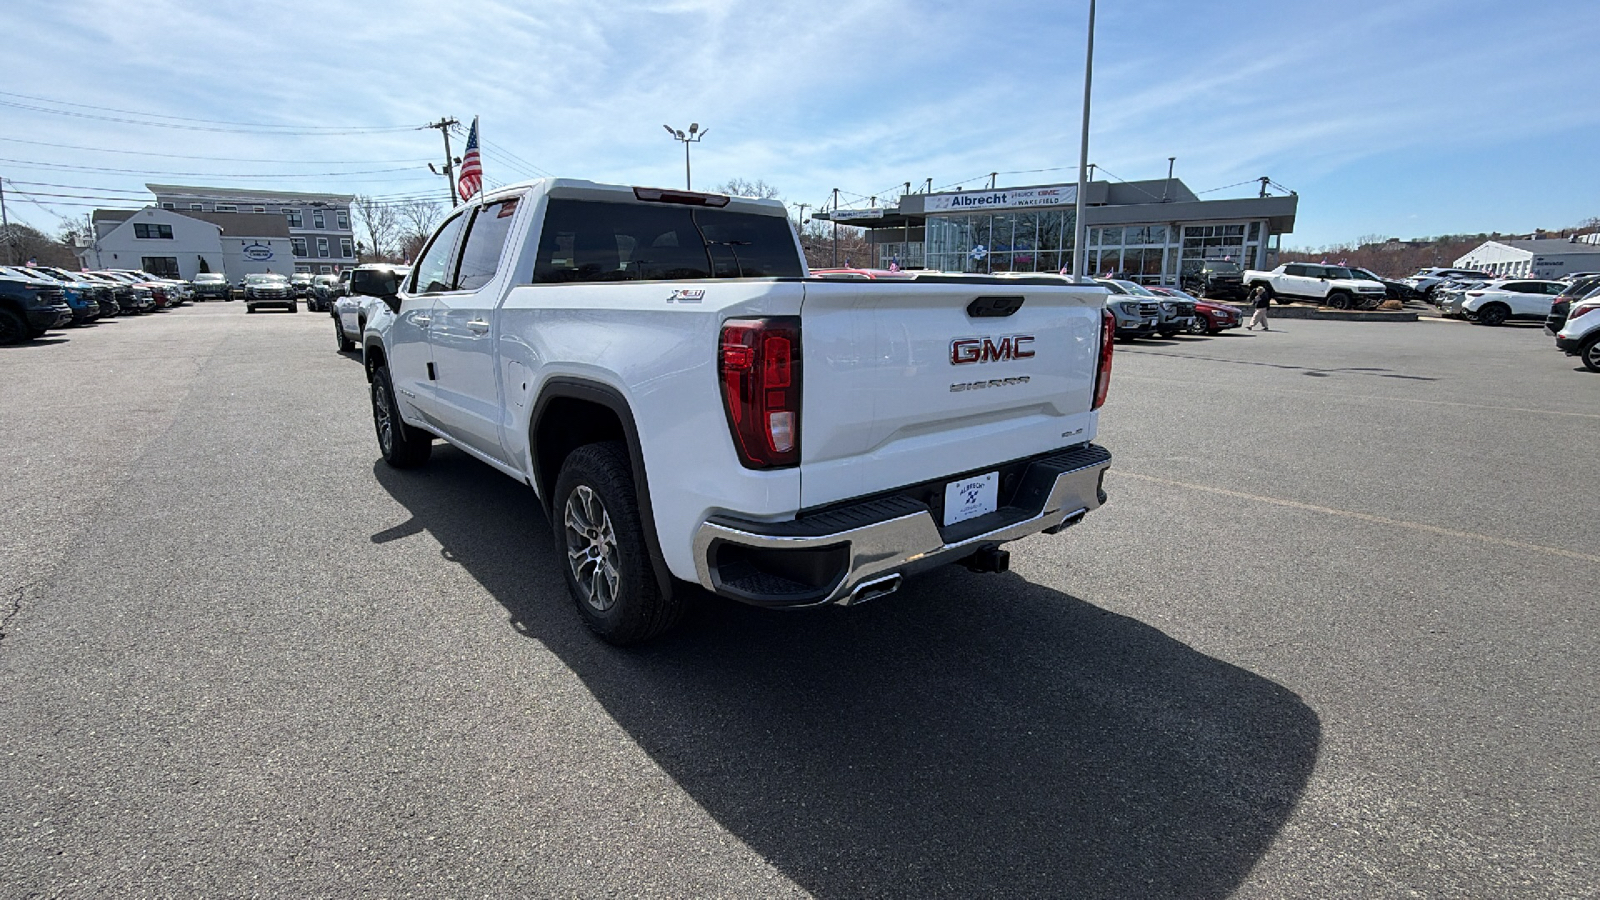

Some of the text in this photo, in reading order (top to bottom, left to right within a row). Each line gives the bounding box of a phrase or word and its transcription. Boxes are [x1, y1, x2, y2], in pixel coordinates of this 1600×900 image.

[951, 193, 1007, 207] Albrecht
[1018, 198, 1059, 206] WAKEFIELD
[949, 334, 1035, 365] GMC
[950, 376, 1030, 392] SIERRA
[960, 482, 985, 495] ALBRECHT
